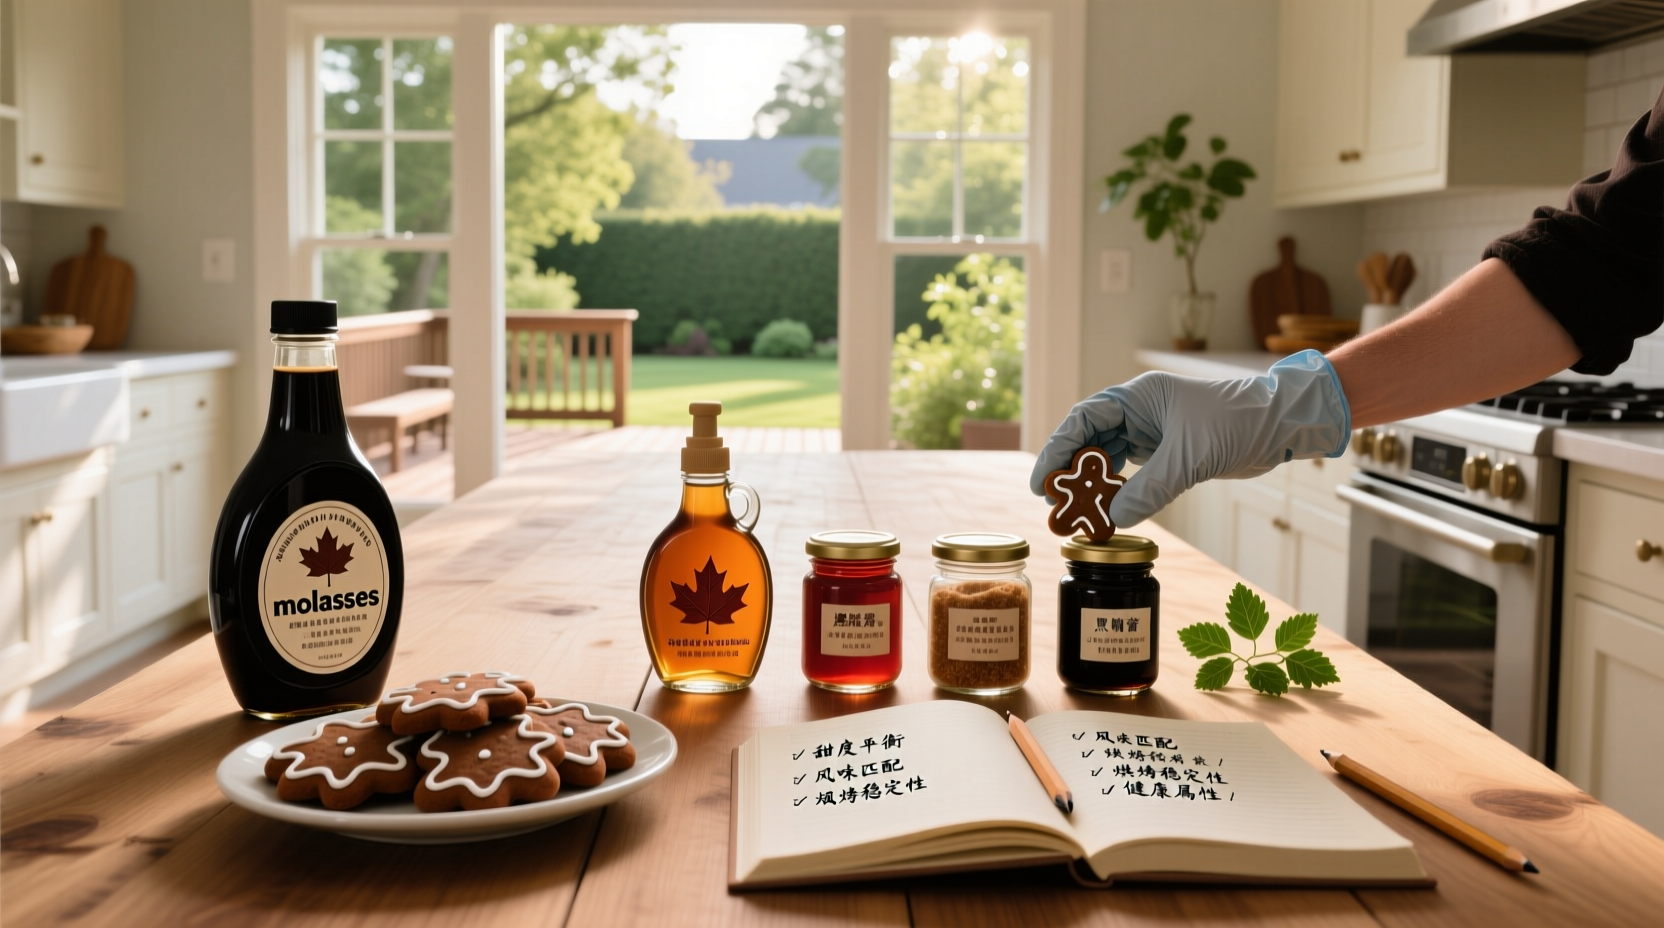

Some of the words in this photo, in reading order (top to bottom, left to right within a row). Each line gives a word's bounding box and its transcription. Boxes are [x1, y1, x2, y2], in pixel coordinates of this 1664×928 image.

[273, 589, 380, 617] molasses
[812, 733, 905, 759] 甜度平衡
[815, 758, 904, 783] 风味匹配
